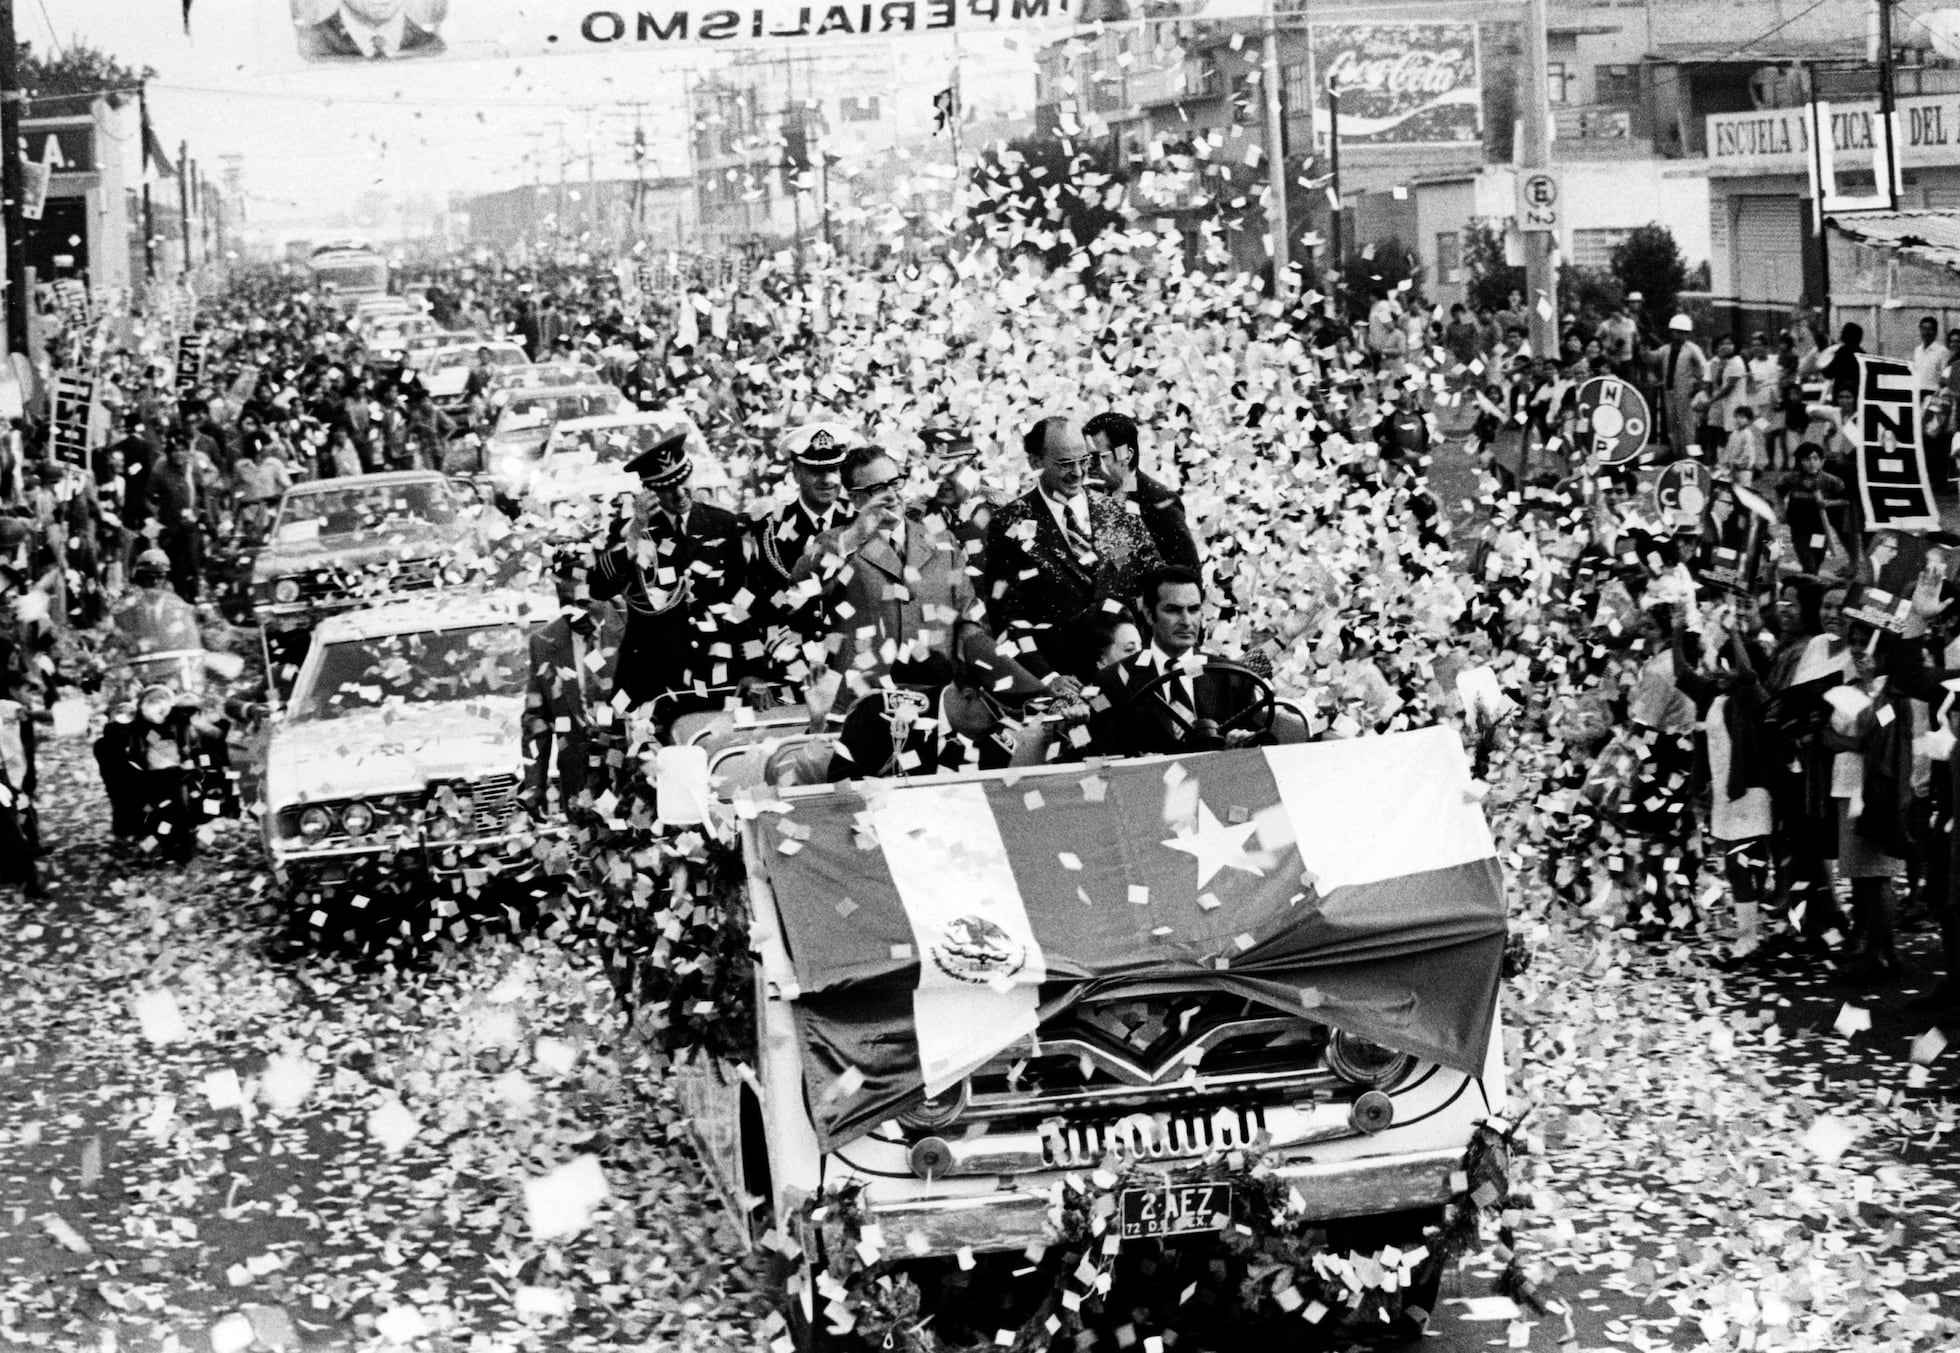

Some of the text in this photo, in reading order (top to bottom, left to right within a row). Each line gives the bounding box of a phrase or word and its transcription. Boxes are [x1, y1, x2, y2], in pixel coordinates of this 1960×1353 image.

[1716, 118, 1791, 157] ESCUELA
[1910, 106, 1947, 146] DEL
[1863, 361, 1932, 523] CNOP
[1126, 1222, 1141, 1234] 72
